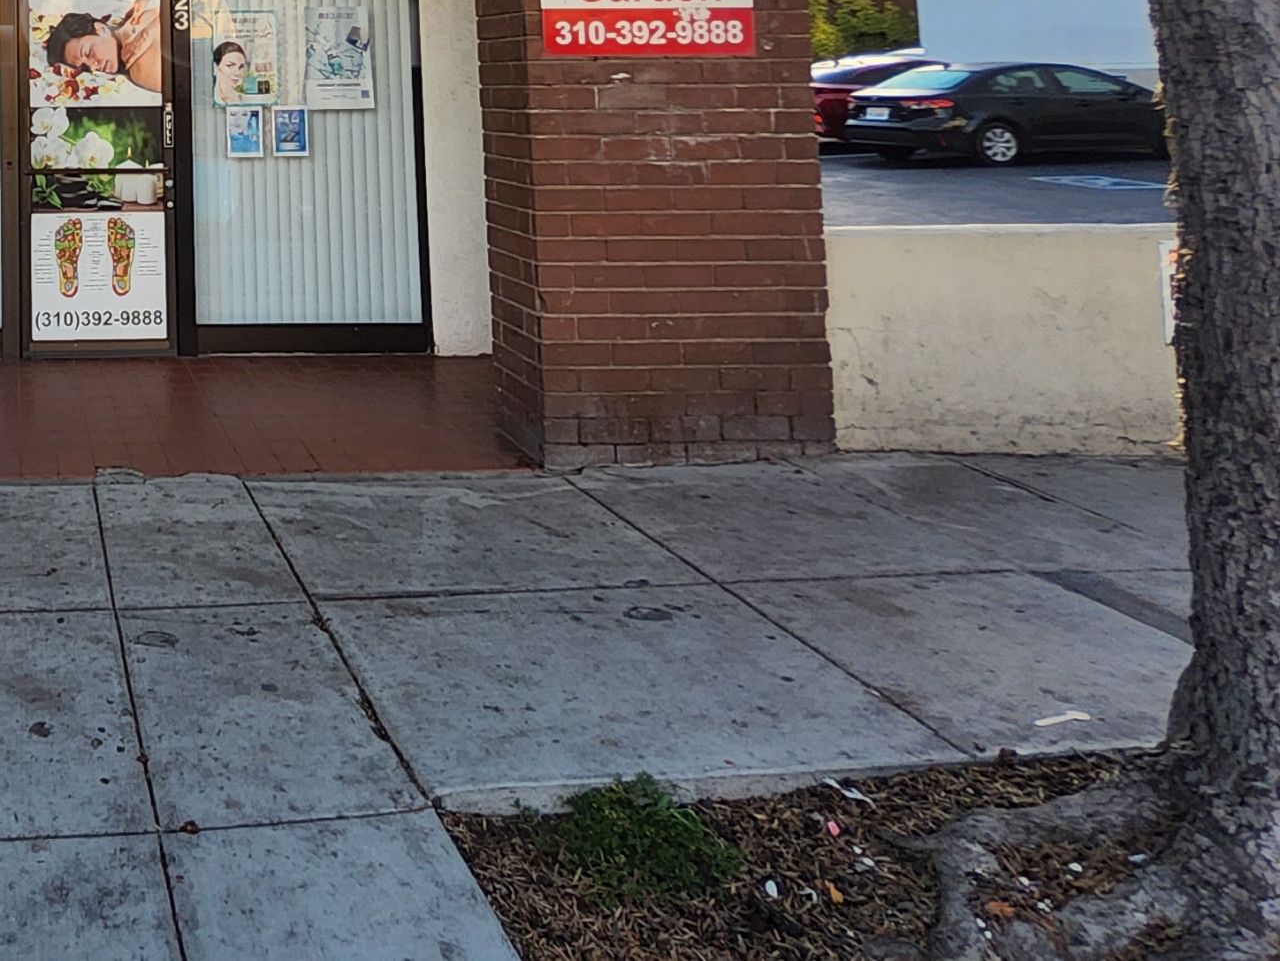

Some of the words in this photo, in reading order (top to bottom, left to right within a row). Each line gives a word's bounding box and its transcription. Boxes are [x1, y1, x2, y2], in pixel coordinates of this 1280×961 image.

[555, 19, 744, 45] 310-392-9888
[165, 113, 173, 145] PULL
[34, 309, 163, 332] (310)392-9888
